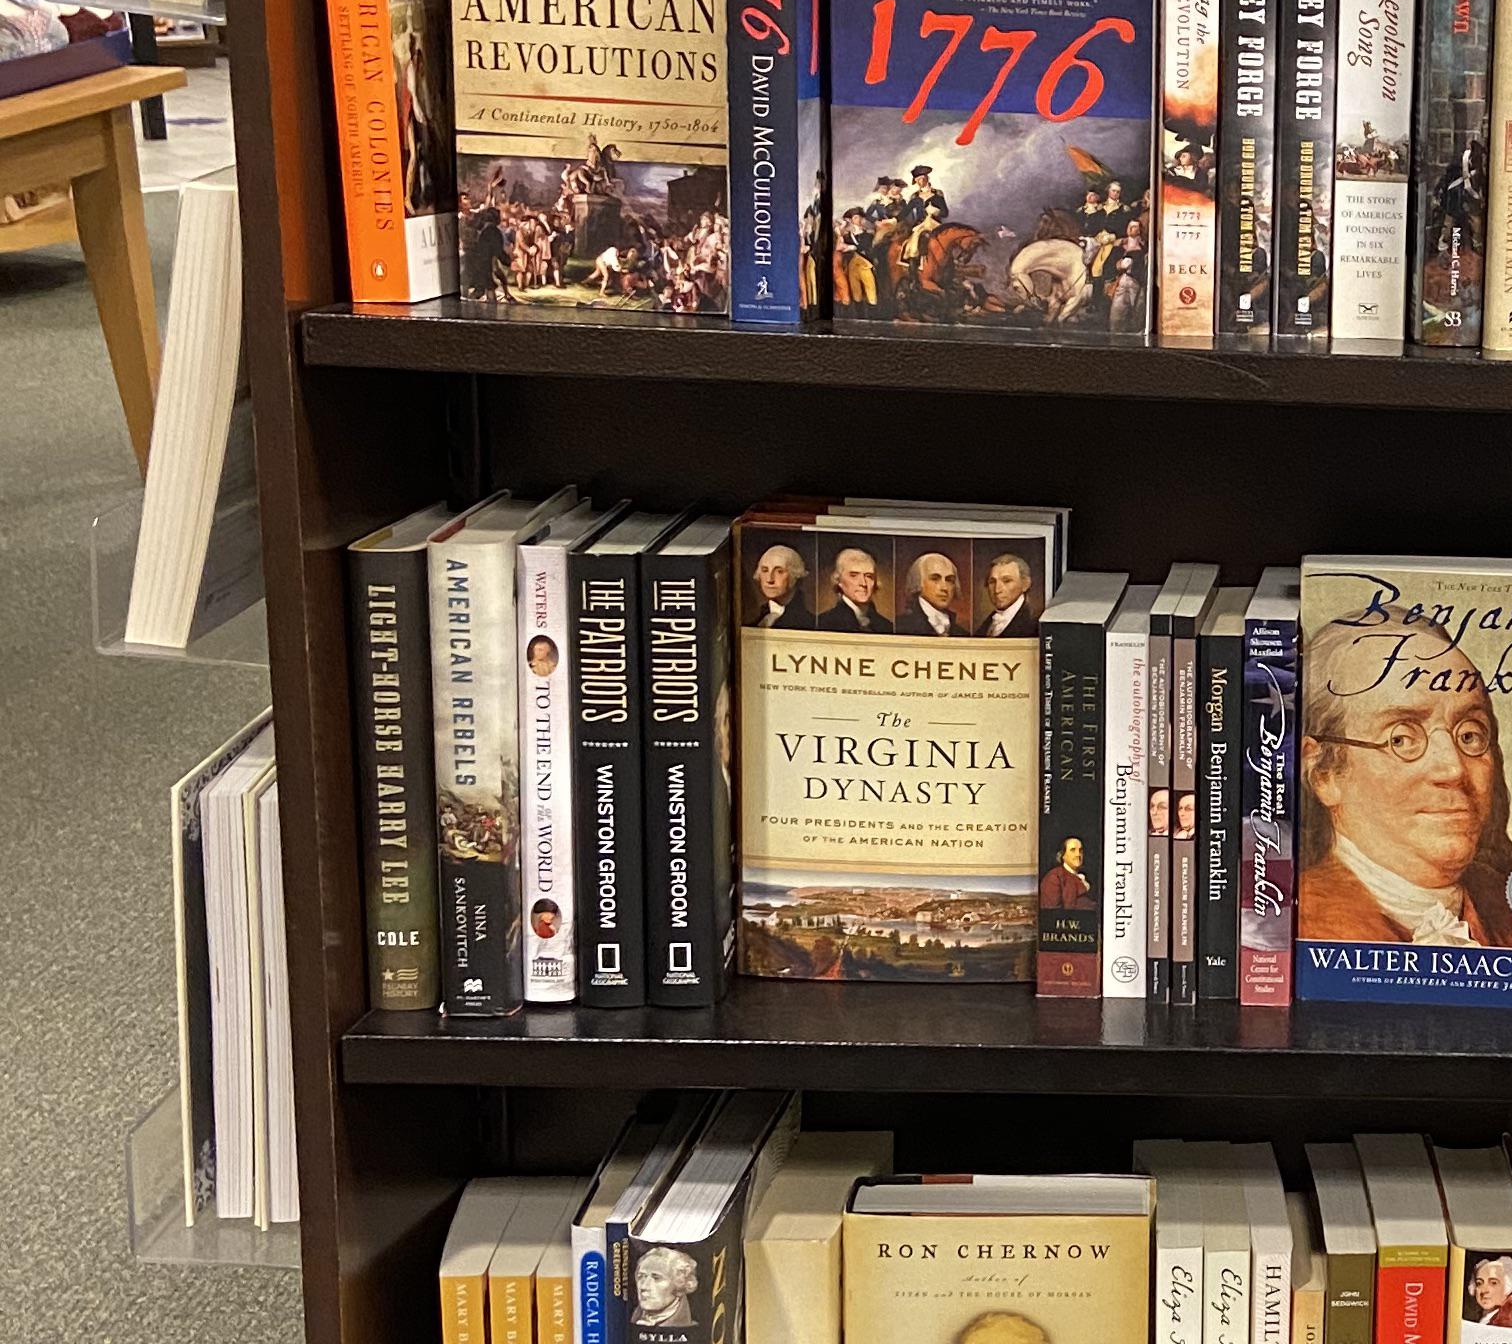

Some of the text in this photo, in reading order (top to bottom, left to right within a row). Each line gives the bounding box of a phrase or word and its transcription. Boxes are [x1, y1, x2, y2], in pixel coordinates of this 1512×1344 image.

[466, 40, 718, 82] REVOLUTIONS
[1236, 35, 1264, 118] FORGE
[1169, 264, 1207, 275] BECK
[579, 579, 628, 724] THE PATRIOTS
[772, 654, 1022, 682] LYNNE CHENEY
[877, 713, 912, 728] The
[777, 734, 1014, 770] VIRGINIA
[803, 778, 986, 805] DYNASTY
[596, 765, 617, 929] WINSTON GROOM
[1308, 947, 1425, 973] WALTER
[878, 1243, 1111, 1259] RON CHERNOW
[639, 1333, 688, 1342] SYLLA
